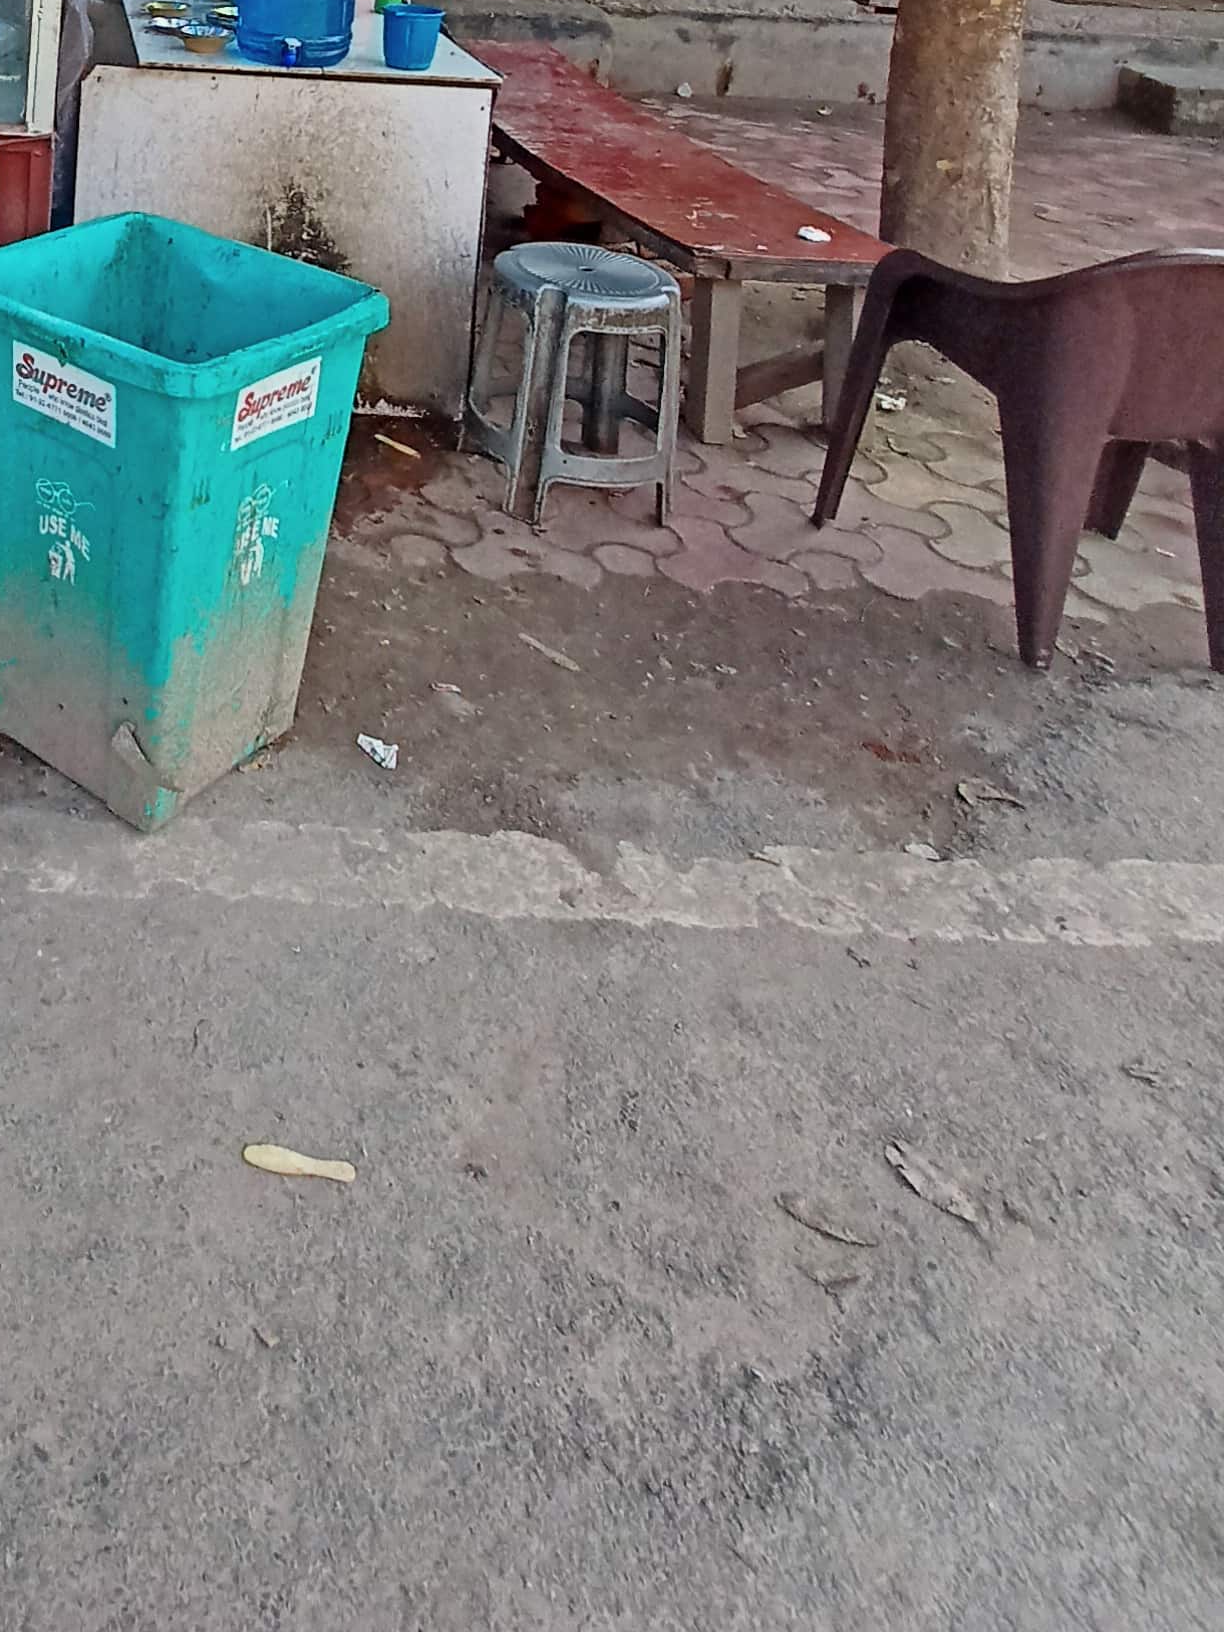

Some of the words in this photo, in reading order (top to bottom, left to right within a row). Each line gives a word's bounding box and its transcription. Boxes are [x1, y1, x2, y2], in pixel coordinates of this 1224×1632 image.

[16, 353, 108, 412] Supreme
[237, 376, 311, 422] Supreme
[39, 514, 67, 538] USE
[70, 524, 91, 561] ME
